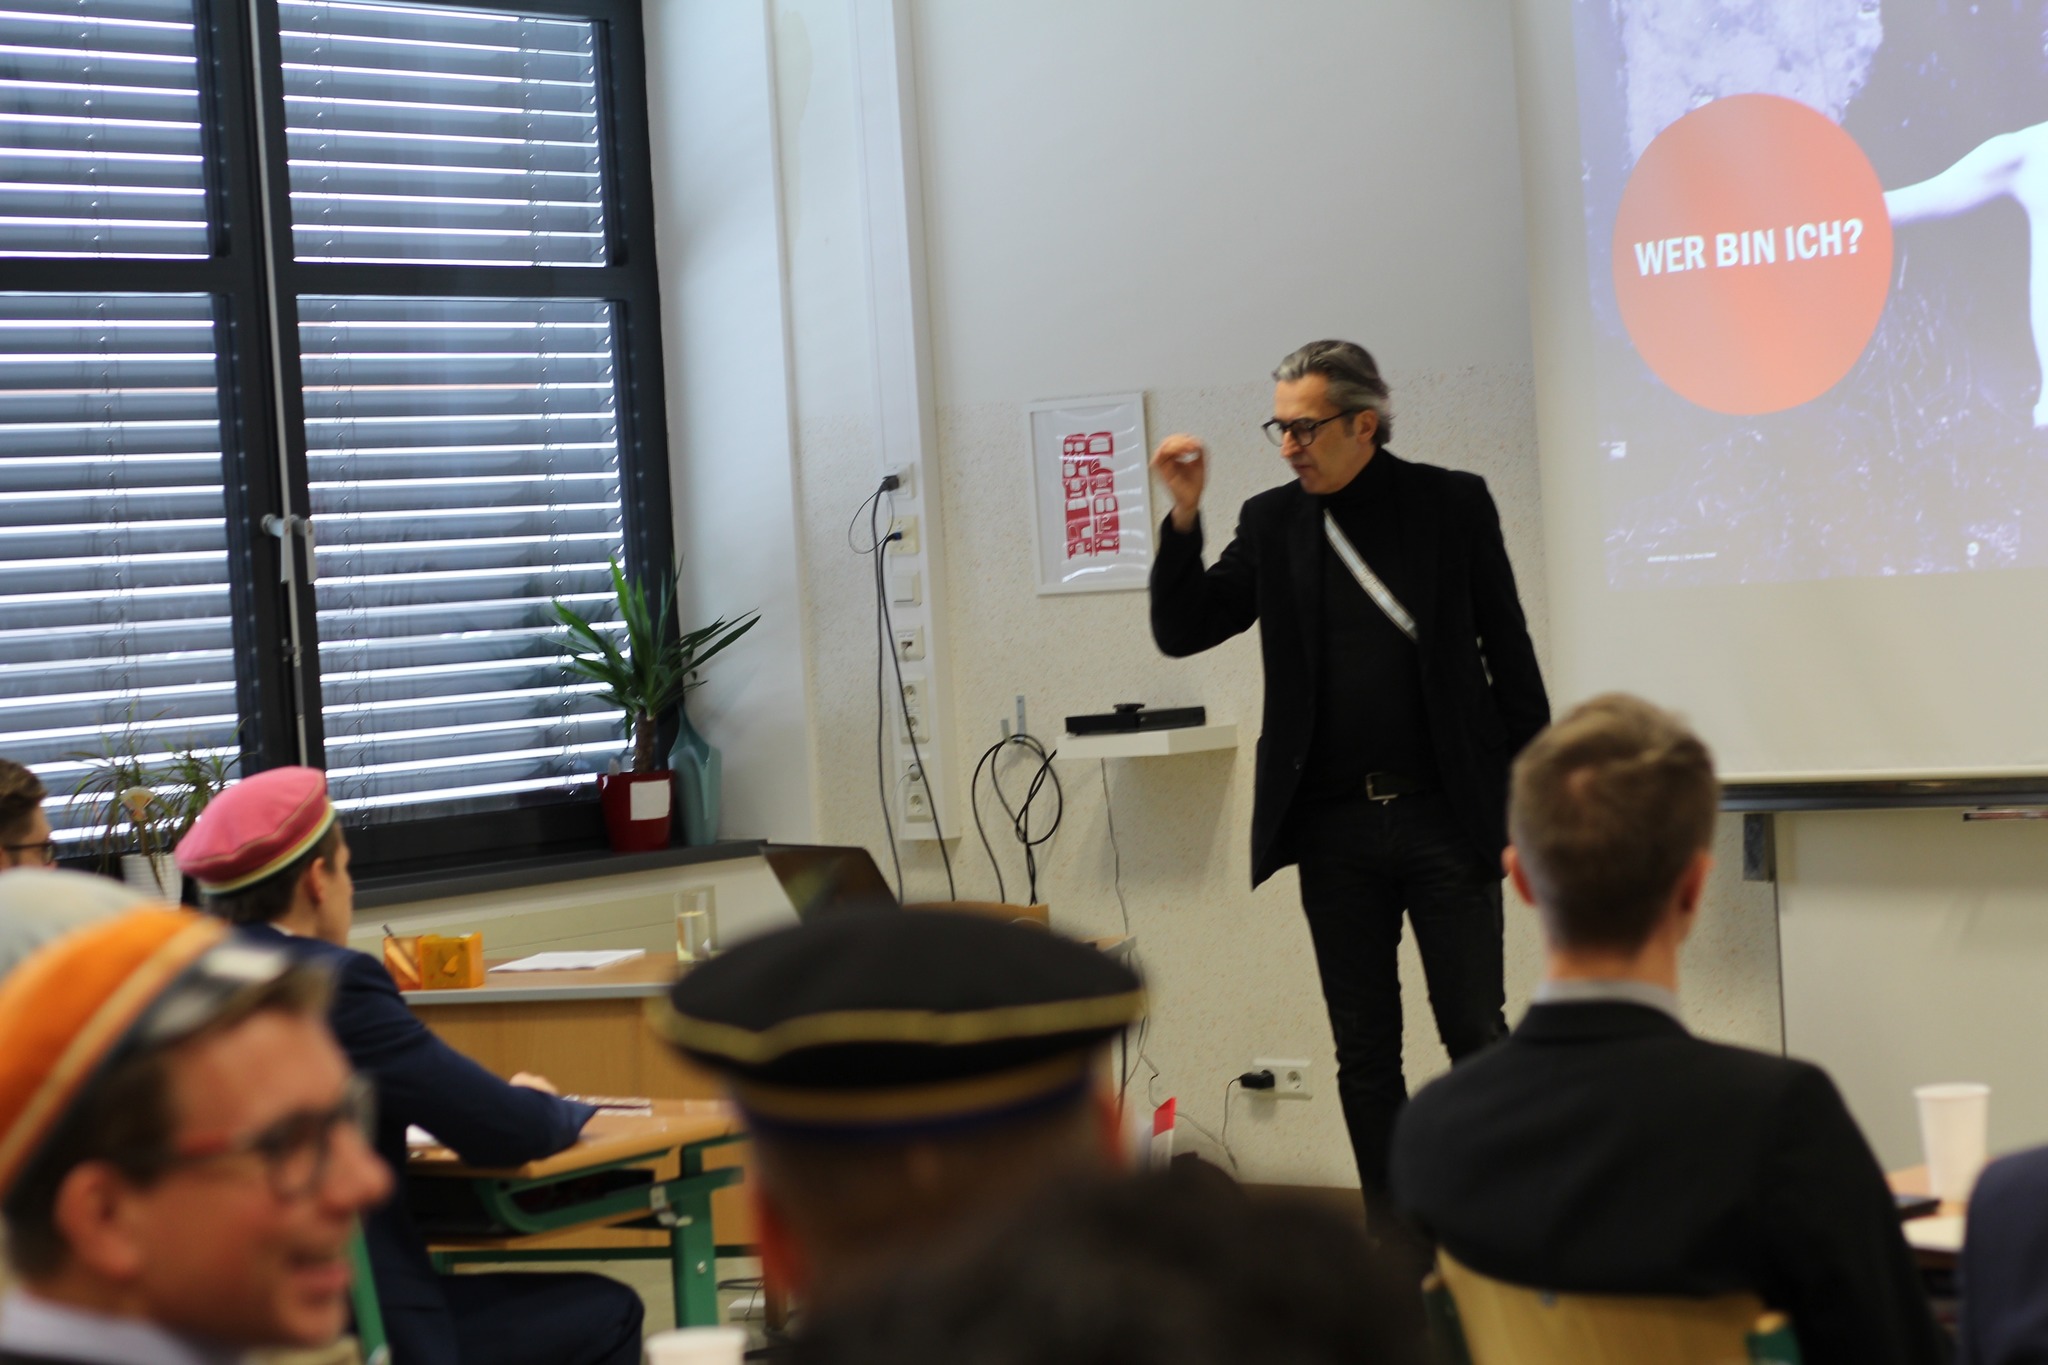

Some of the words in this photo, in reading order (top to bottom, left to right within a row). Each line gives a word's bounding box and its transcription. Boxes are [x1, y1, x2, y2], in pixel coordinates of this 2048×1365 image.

[1634, 235, 1707, 277] WER
[1715, 228, 1776, 267] BIN
[1784, 217, 1864, 262] ICH?
